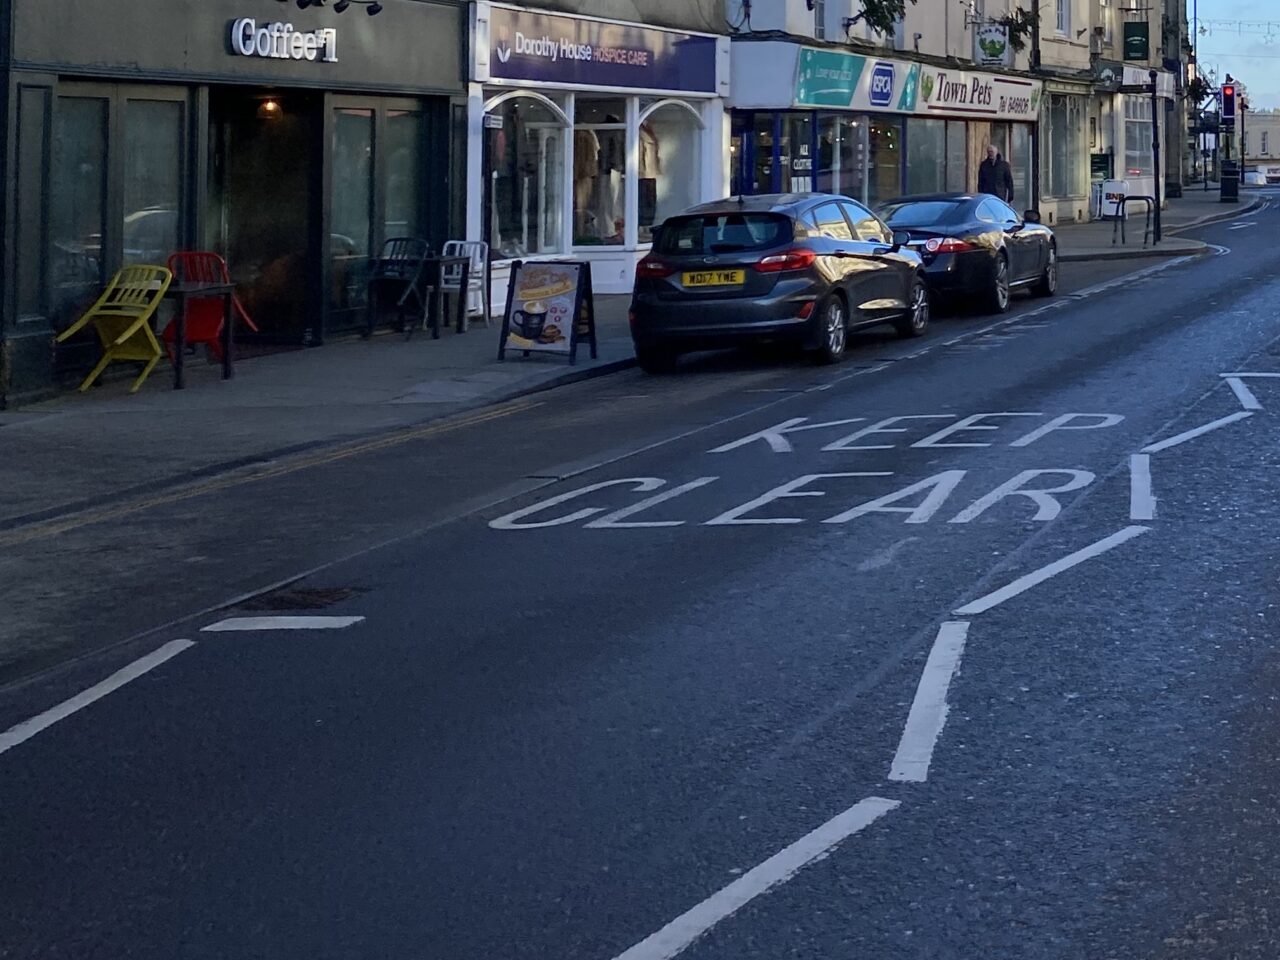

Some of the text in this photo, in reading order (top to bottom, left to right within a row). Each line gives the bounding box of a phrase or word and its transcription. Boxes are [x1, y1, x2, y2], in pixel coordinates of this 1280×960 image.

[515, 31, 647, 66] Dorothy House HOSPICE CARE
[873, 75, 891, 93] RSPCA
[936, 72, 993, 106] Town Pets
[706, 412, 1126, 454] KEEP
[487, 469, 1097, 530] CLEAR
